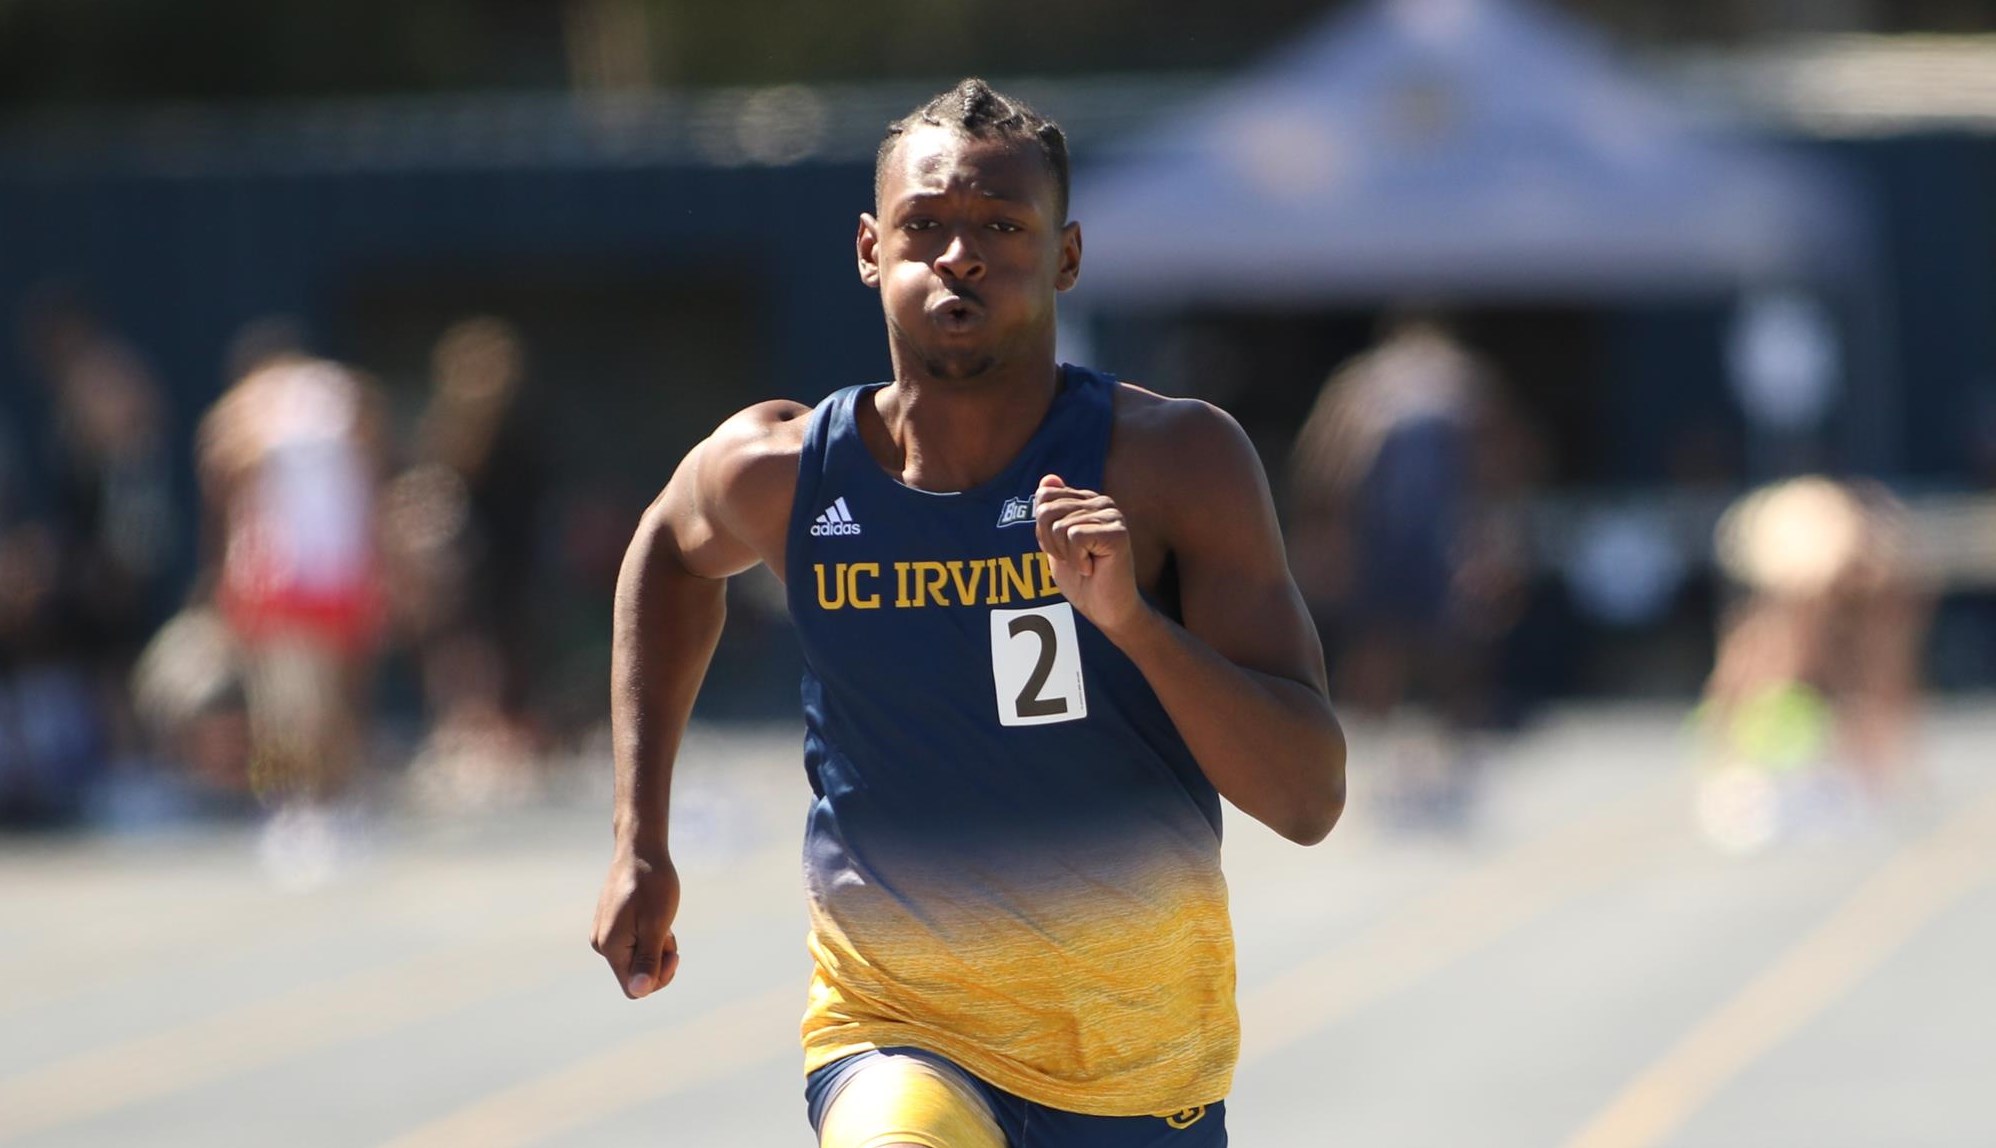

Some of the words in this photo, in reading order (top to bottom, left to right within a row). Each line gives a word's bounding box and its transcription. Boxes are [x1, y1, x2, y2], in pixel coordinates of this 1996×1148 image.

[810, 521, 861, 536] adidas
[1001, 501, 1028, 523] BIG
[814, 562, 881, 610] UC
[1008, 614, 1068, 718] 2
